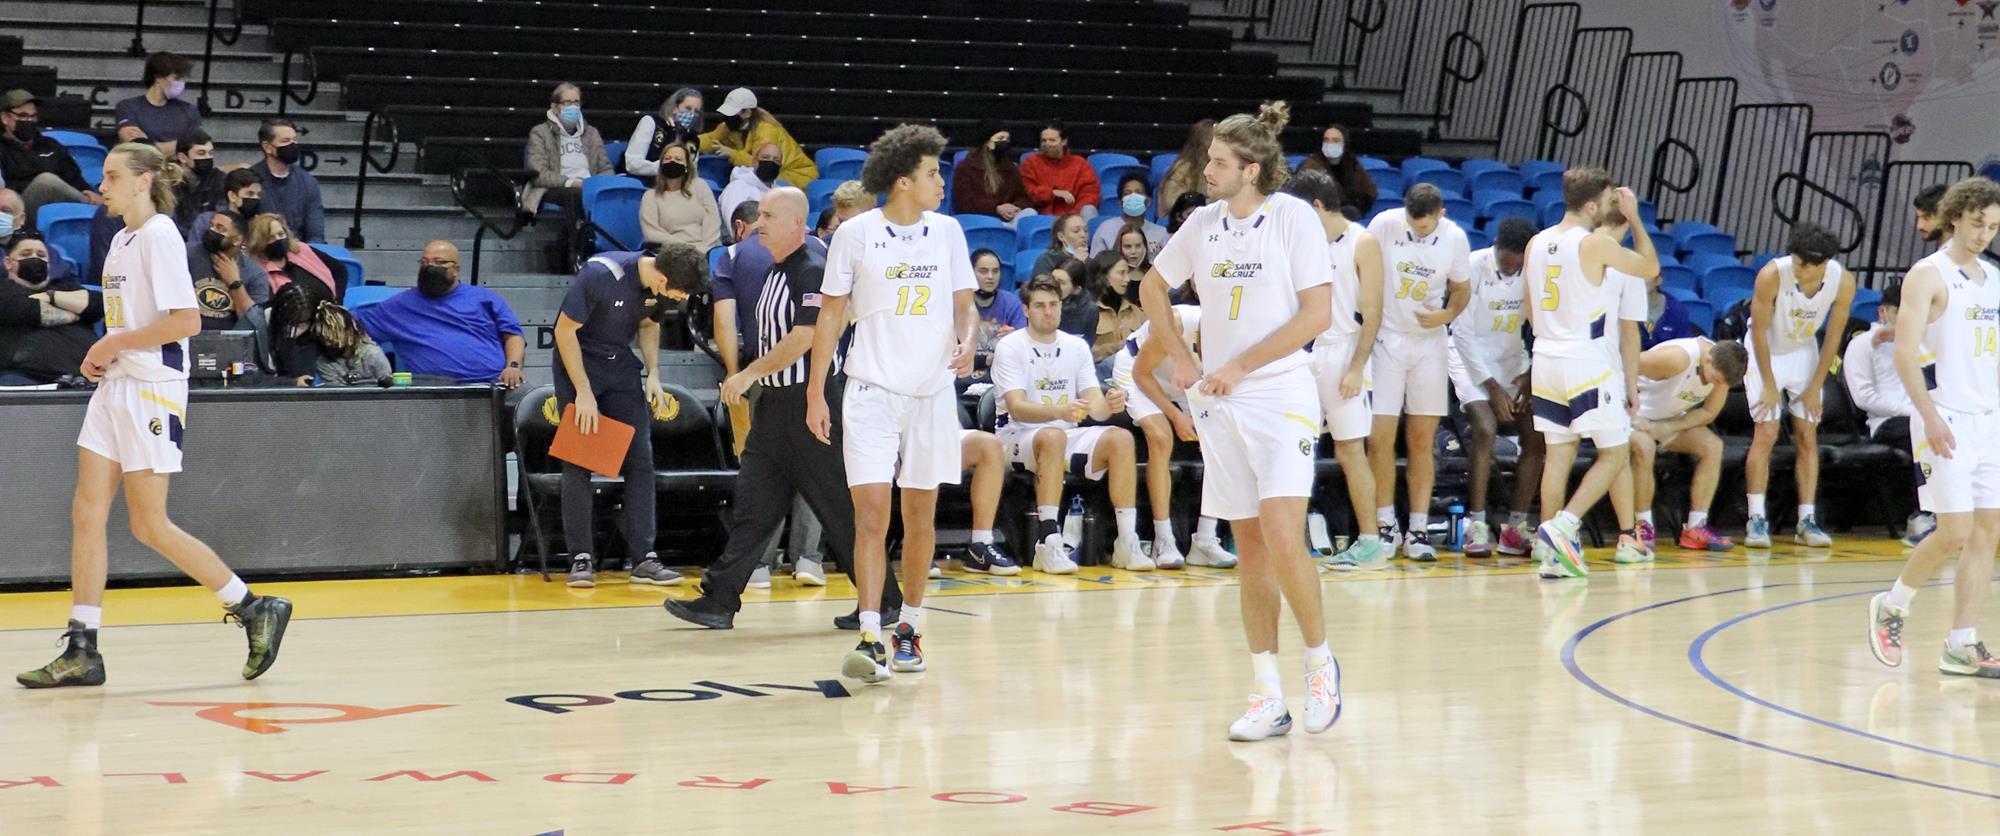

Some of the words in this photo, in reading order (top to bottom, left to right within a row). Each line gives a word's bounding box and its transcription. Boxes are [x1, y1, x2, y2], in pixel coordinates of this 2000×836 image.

[226, 89, 244, 109] D
[1232, 270, 1255, 278] CRUZ
[1415, 265, 1436, 274] SANTA
[895, 285, 931, 316] 12
[1228, 285, 1243, 321] 1
[1540, 265, 1562, 312] 5
[1974, 327, 1997, 357] 14
